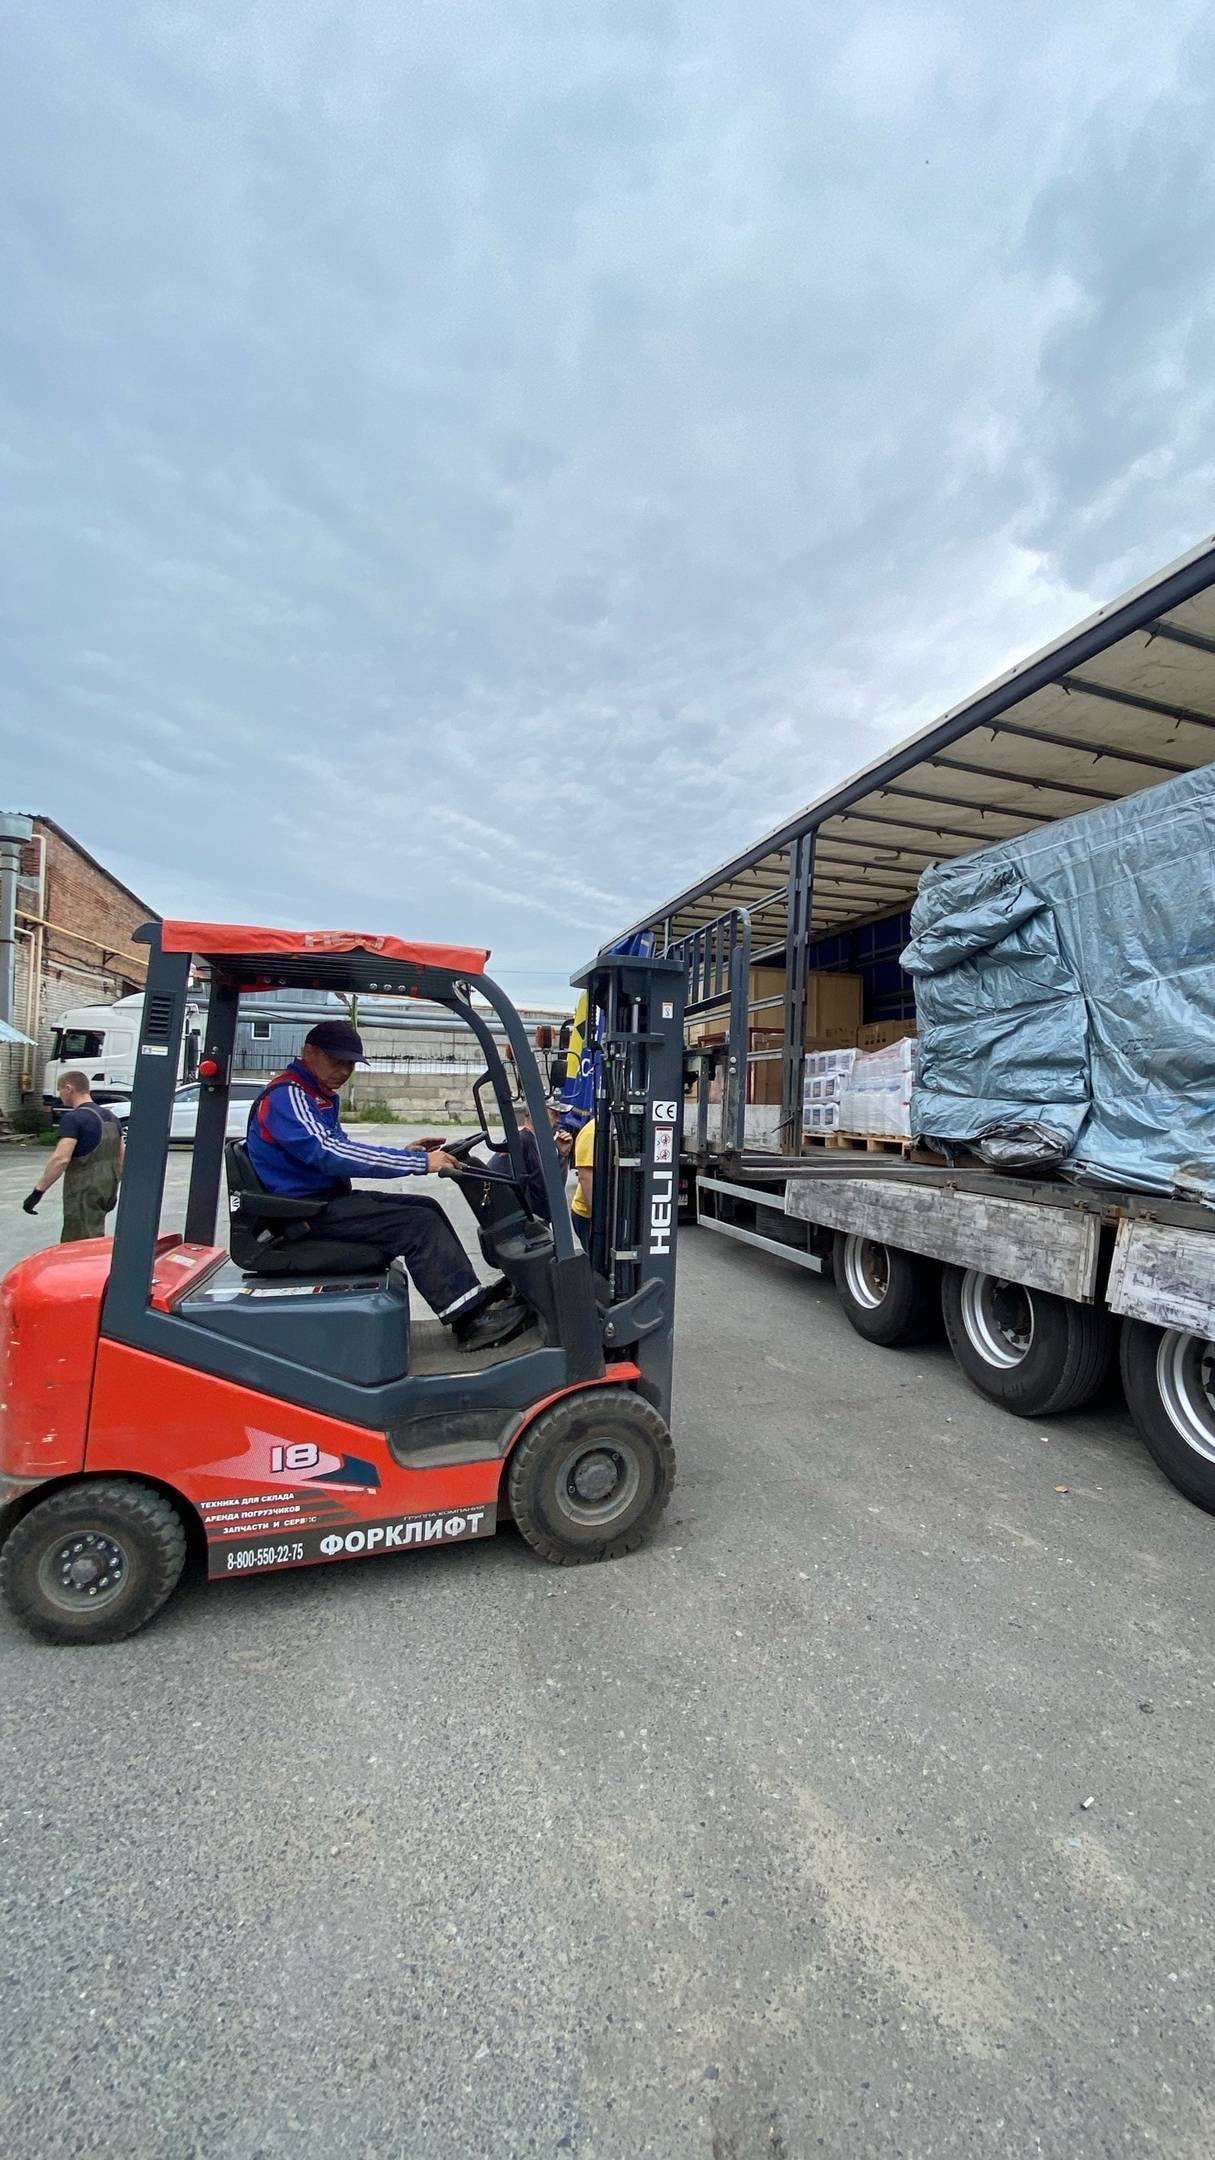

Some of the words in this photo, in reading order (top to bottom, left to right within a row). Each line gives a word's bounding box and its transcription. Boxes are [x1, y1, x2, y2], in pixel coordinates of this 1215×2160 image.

[654, 1103, 676, 1120] CE
[650, 1170, 673, 1255] HELI
[271, 1442, 319, 1473] 18
[200, 1498, 240, 1510] ТЕХНИКА
[241, 1496, 260, 1506] ДЛЯ
[261, 1493, 295, 1504] СКЛАДА
[204, 1512, 240, 1524] АРЕНДА
[241, 1505, 301, 1519] ПОГРУЗЧИКОВ
[223, 1520, 269, 1534] ЗАПЧАСТИ
[273, 1521, 281, 1529] И
[320, 1512, 484, 1556] ФОРКЛИФТ
[227, 1542, 304, 1570] 8-800-550-22-75
